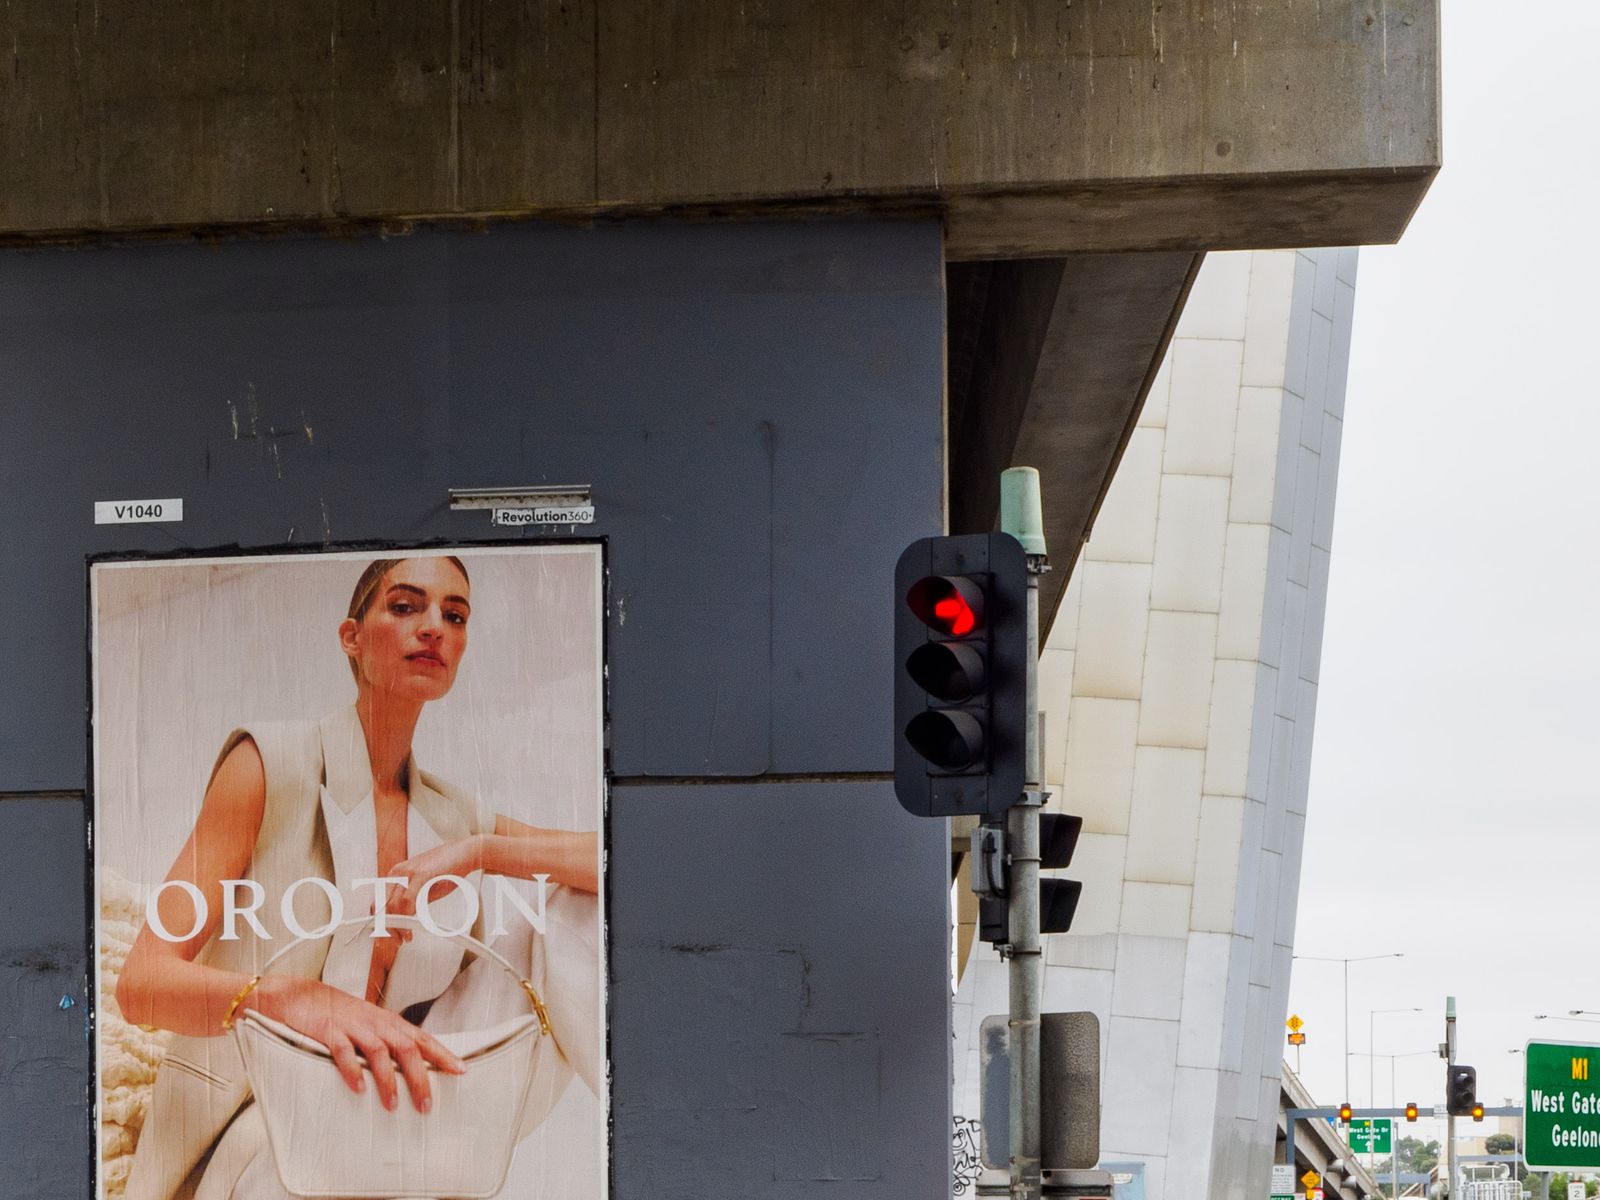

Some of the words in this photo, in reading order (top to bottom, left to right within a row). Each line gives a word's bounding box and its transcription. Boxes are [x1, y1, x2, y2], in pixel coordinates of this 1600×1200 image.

[115, 504, 162, 519] V1040
[145, 873, 552, 943] OROTON
[1571, 1057, 1588, 1080] M1
[1531, 1089, 1565, 1113] West
[1551, 1123, 1600, 1148] Geelon
